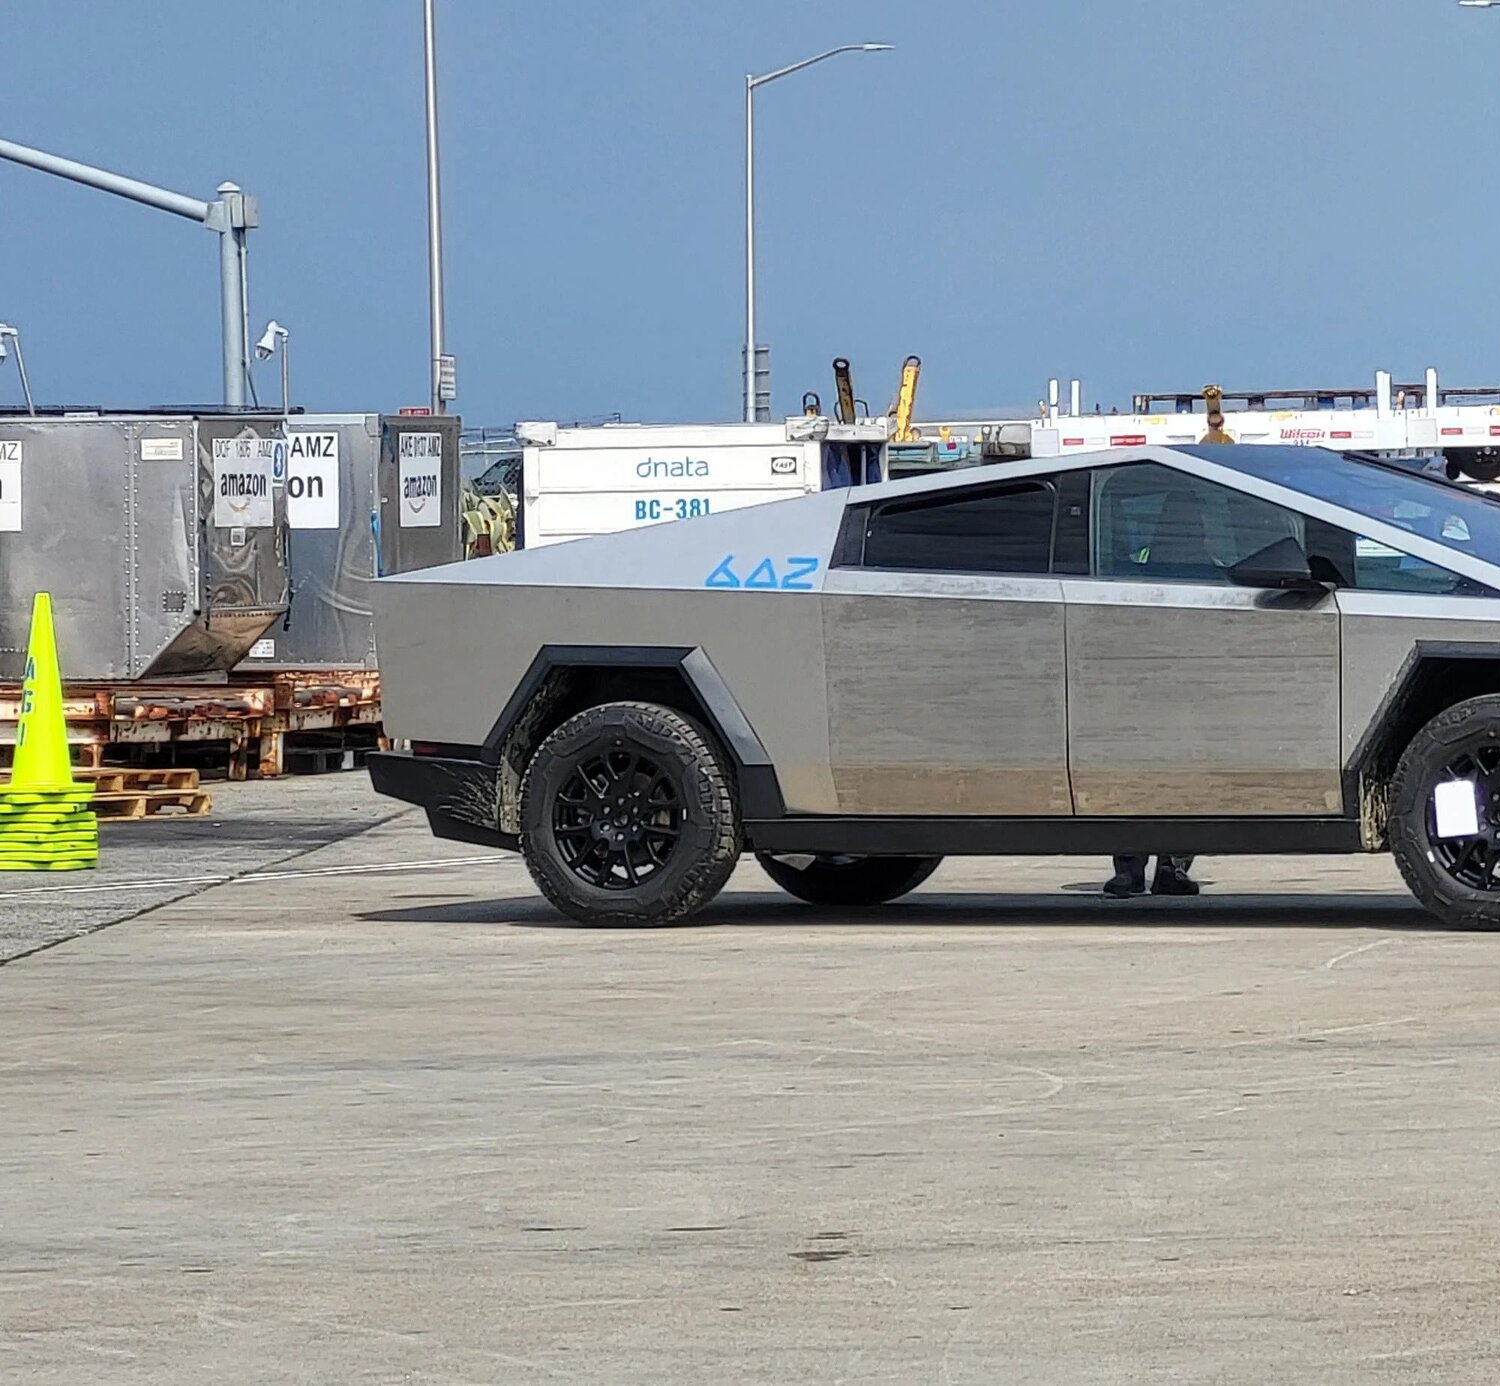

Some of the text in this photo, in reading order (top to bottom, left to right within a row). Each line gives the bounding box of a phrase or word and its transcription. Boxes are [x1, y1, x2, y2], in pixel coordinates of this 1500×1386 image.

[290, 436, 335, 458] AMZ
[636, 456, 710, 478] dnata
[221, 472, 267, 497] amazon
[404, 474, 438, 498] amazon
[635, 498, 711, 520] BC-381
